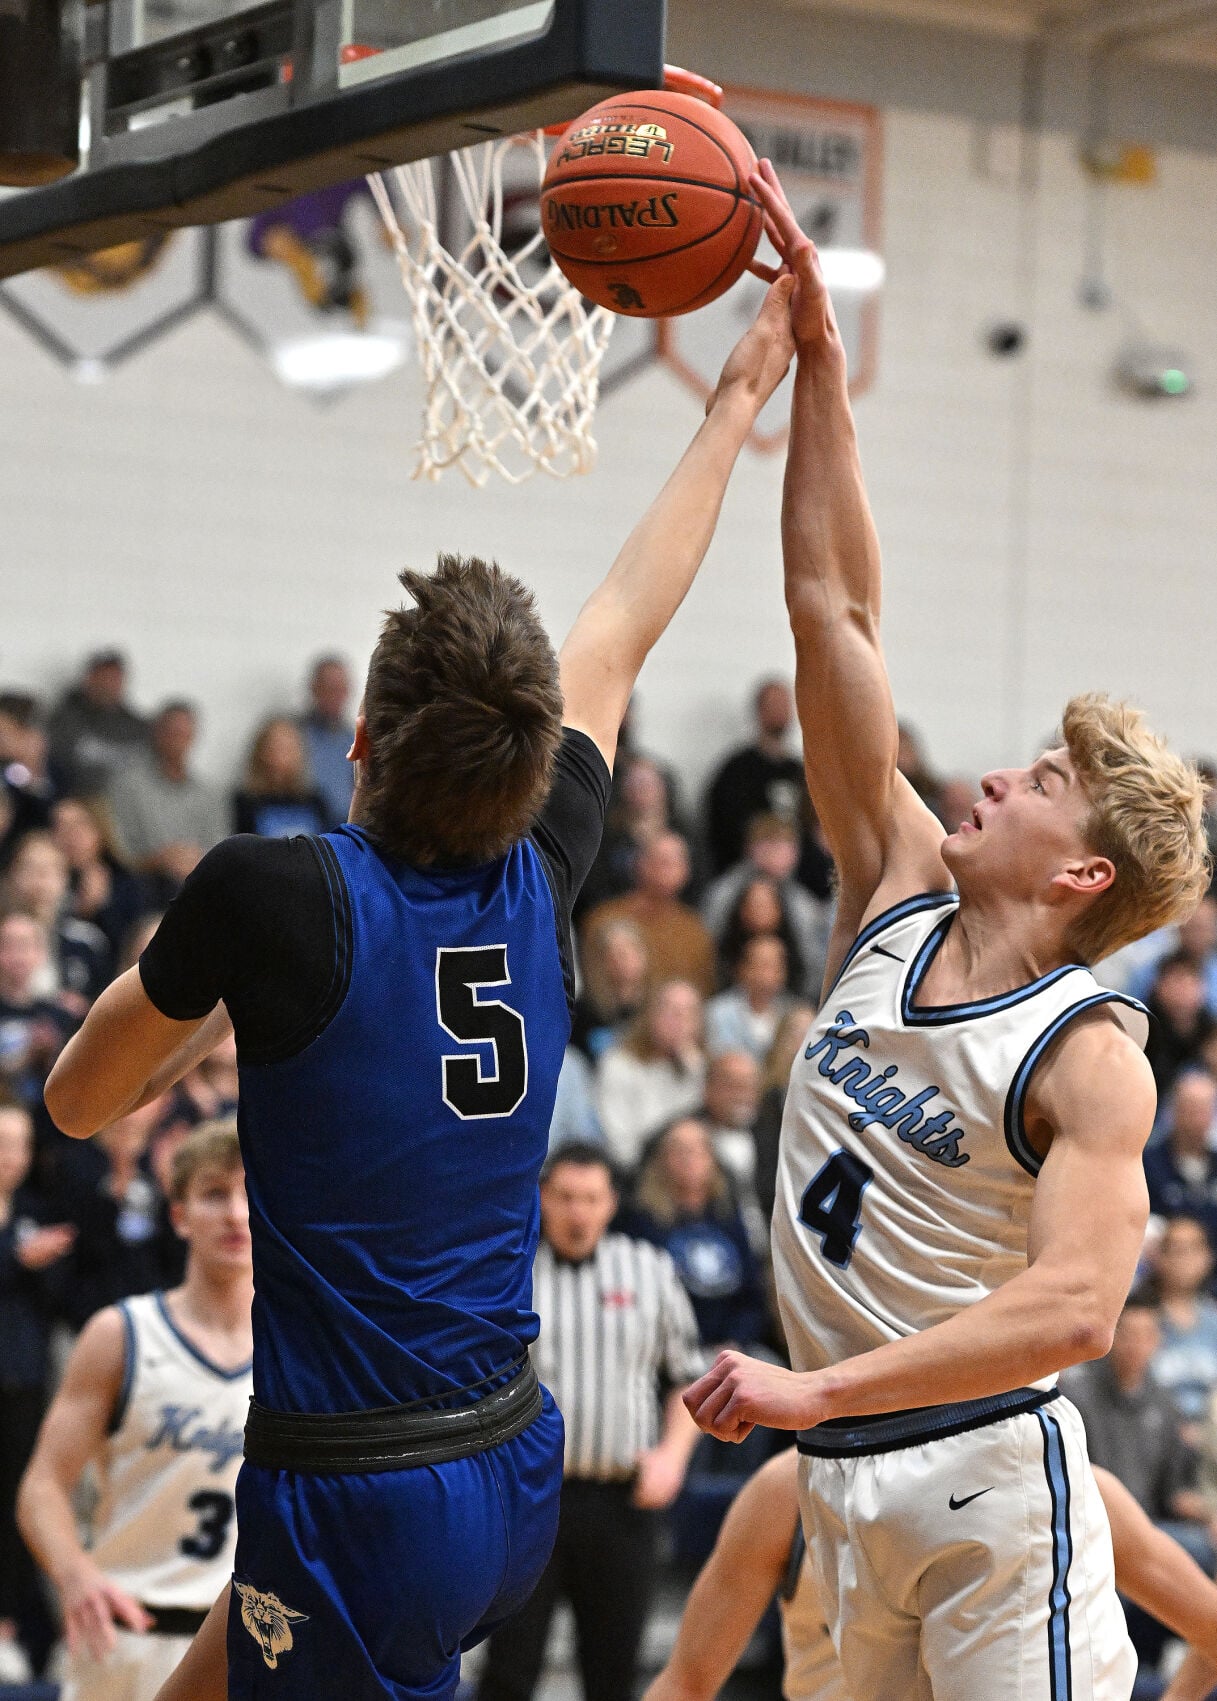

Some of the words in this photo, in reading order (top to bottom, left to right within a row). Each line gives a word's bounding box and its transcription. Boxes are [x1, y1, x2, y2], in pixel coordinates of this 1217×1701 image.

[556, 136, 675, 167] LEGACY
[547, 191, 679, 232] SPALDING
[435, 943, 528, 1120] 5
[804, 1009, 970, 1168] Knights
[796, 1146, 875, 1270] 4
[177, 1486, 236, 1562] 3
